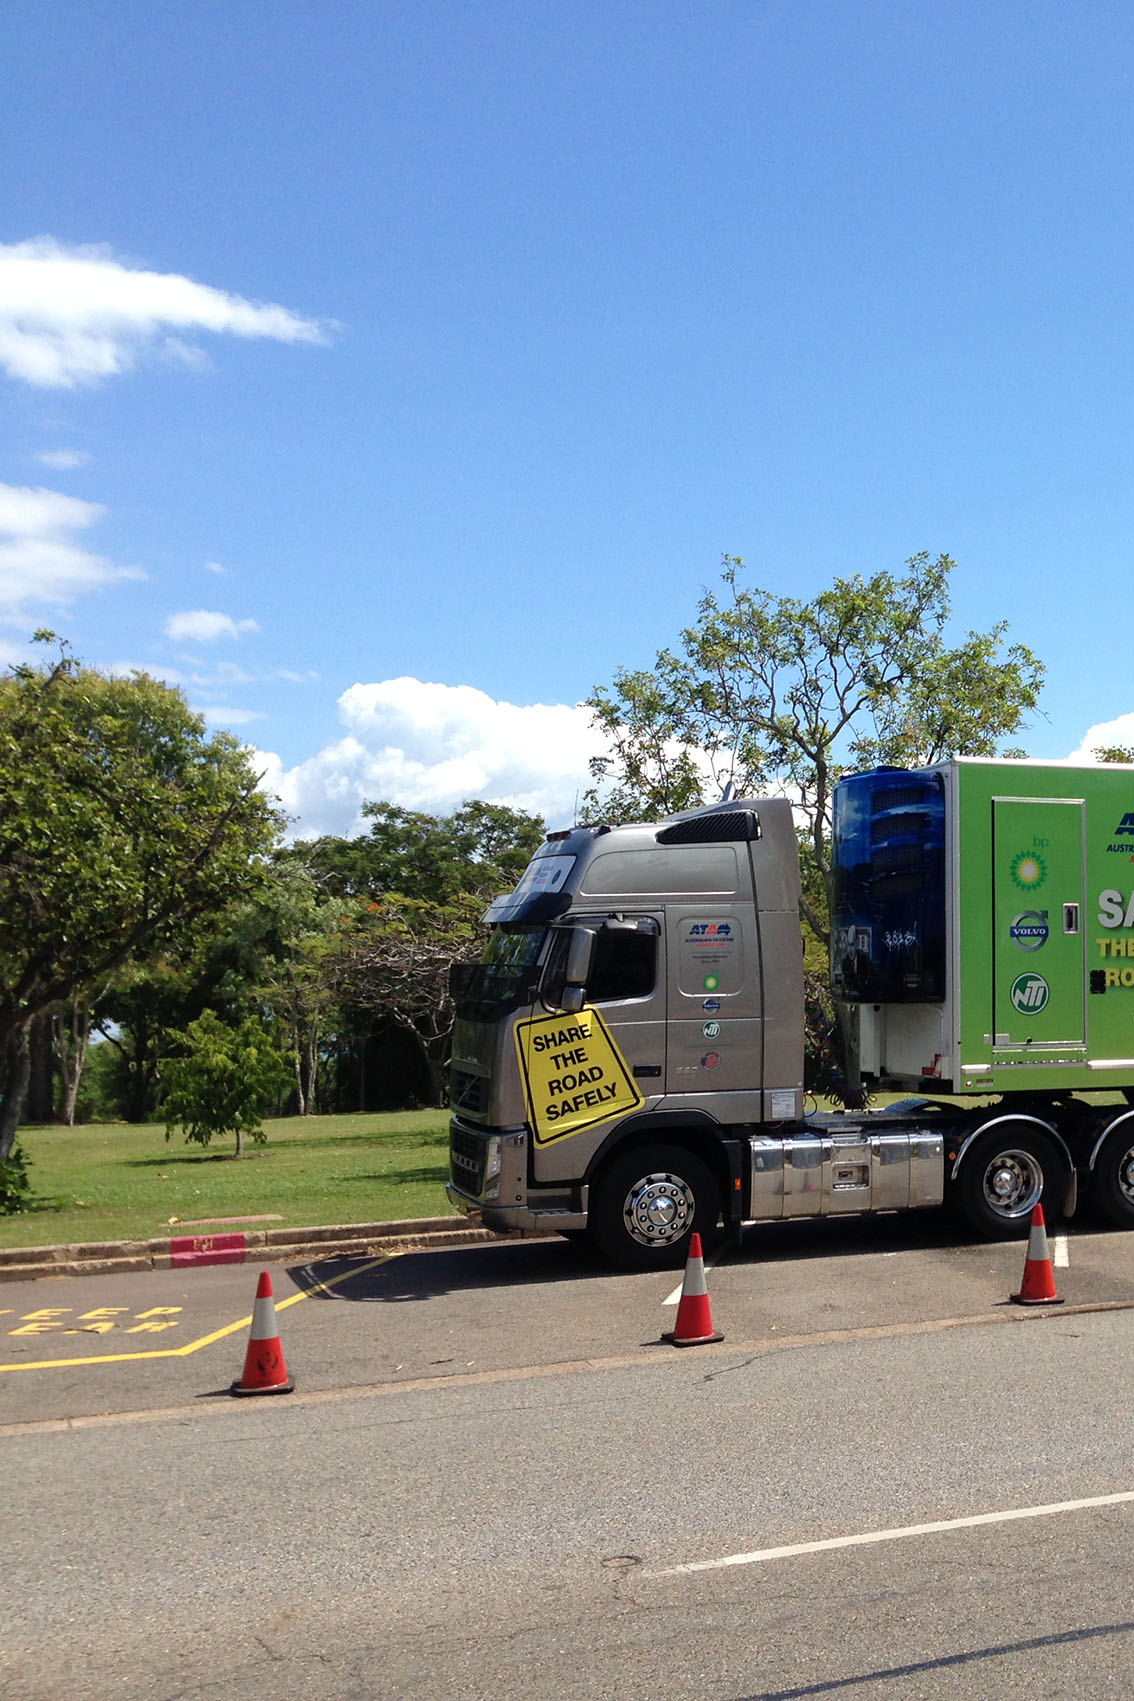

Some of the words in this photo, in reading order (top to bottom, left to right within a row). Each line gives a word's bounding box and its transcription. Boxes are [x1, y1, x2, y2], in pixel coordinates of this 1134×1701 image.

[1033, 834, 1048, 850] bp
[689, 924, 717, 935] ATA
[1014, 981, 1047, 1007] NTI
[533, 1024, 592, 1052] SHARE
[550, 1047, 588, 1070] THE
[548, 1066, 604, 1096] ROAD
[546, 1082, 617, 1121] SAFELY
[0, 1307, 183, 1320] EEP
